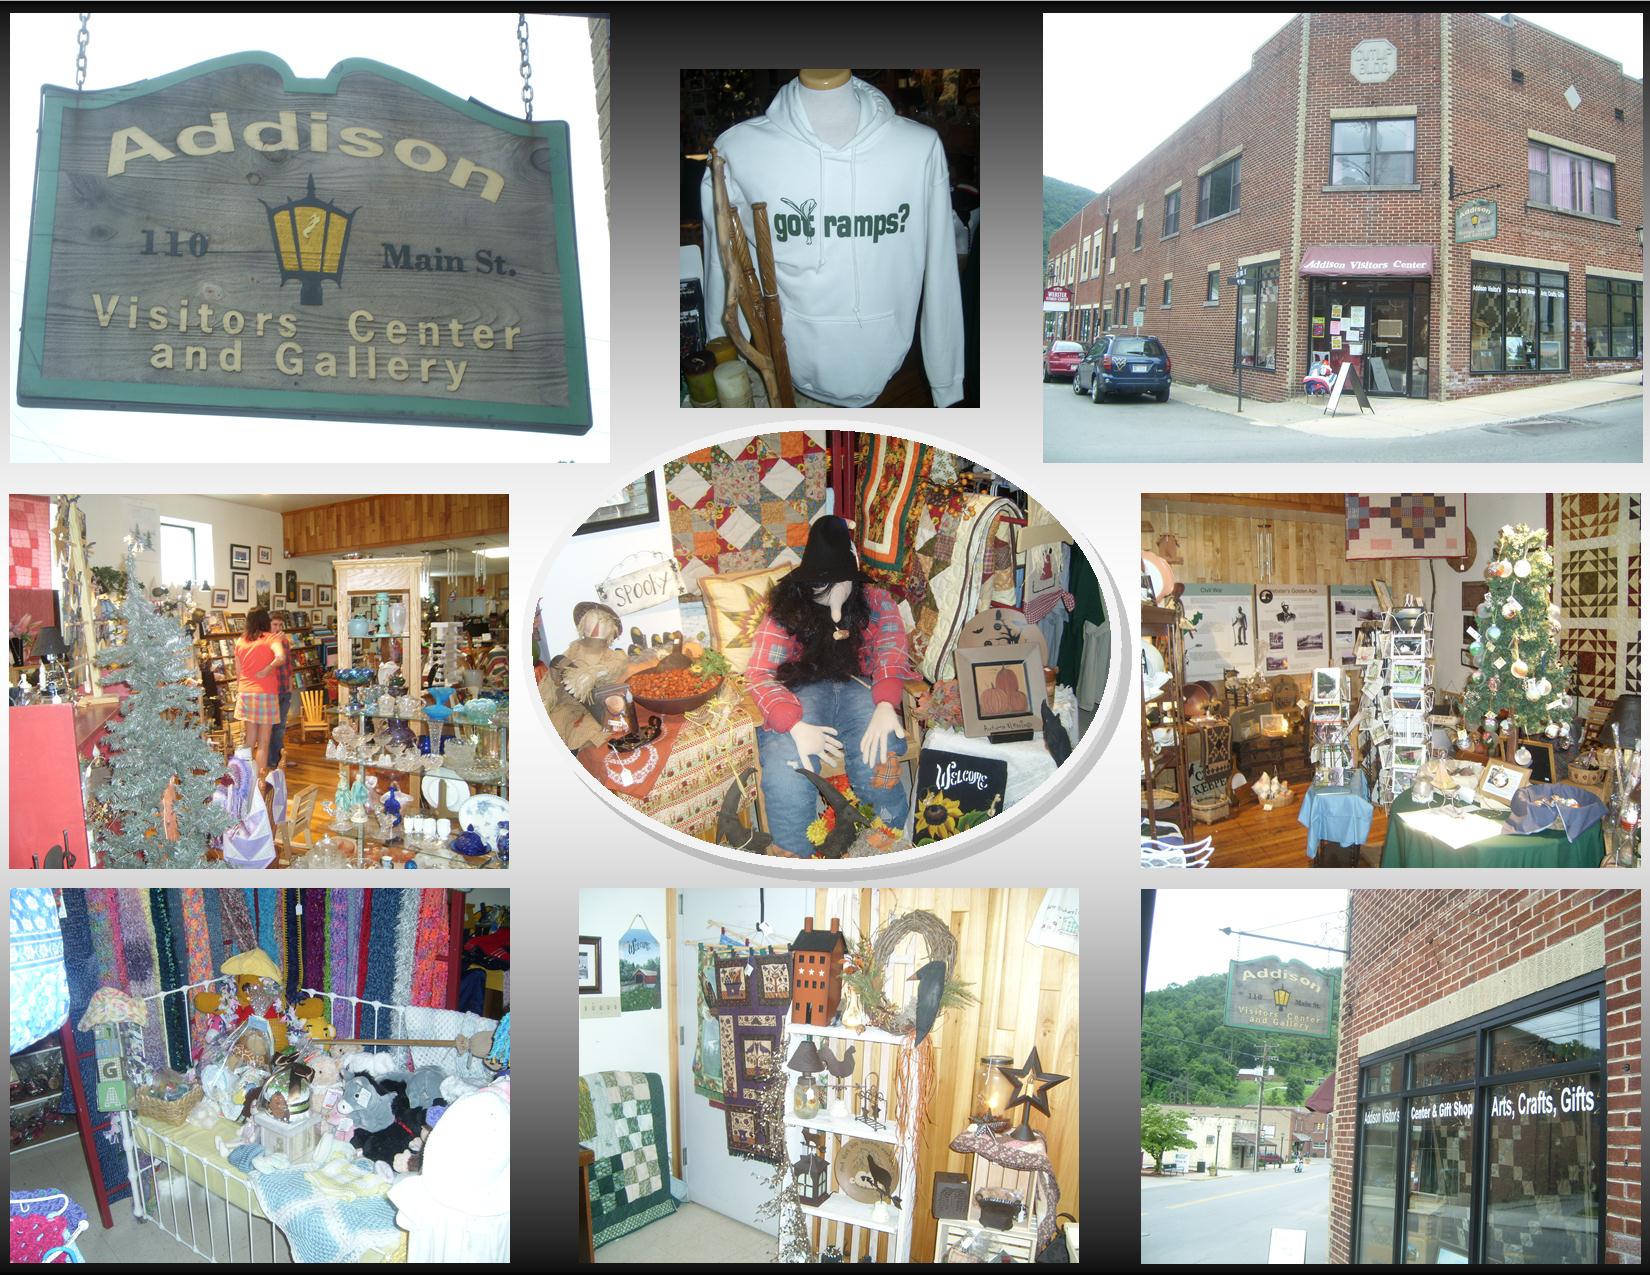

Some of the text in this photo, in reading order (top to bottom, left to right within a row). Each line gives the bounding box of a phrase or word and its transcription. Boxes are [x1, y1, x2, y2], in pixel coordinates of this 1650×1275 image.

[106, 111, 506, 204] Addison
[773, 202, 911, 243] got ramps?
[1459, 206, 1491, 219] Addison
[139, 228, 210, 259] 110
[380, 242, 518, 278] Main St.
[1303, 259, 1427, 270] Addison Visitors Center
[92, 292, 521, 351] Visitors Center
[149, 339, 469, 393] and Gallery
[1192, 776, 1228, 796] KEEPE
[1242, 967, 1321, 993] Addison
[1248, 992, 1263, 1001] 110
[1238, 1005, 1321, 1023] Visitors Center
[1249, 1016, 1310, 1031] and Gallery
[102, 1061, 118, 1079] G
[104, 1086, 121, 1108] A
[1364, 1086, 1595, 1125] Addison Visitor's Center & Gift Shop Arts, Crafts, Gifts
